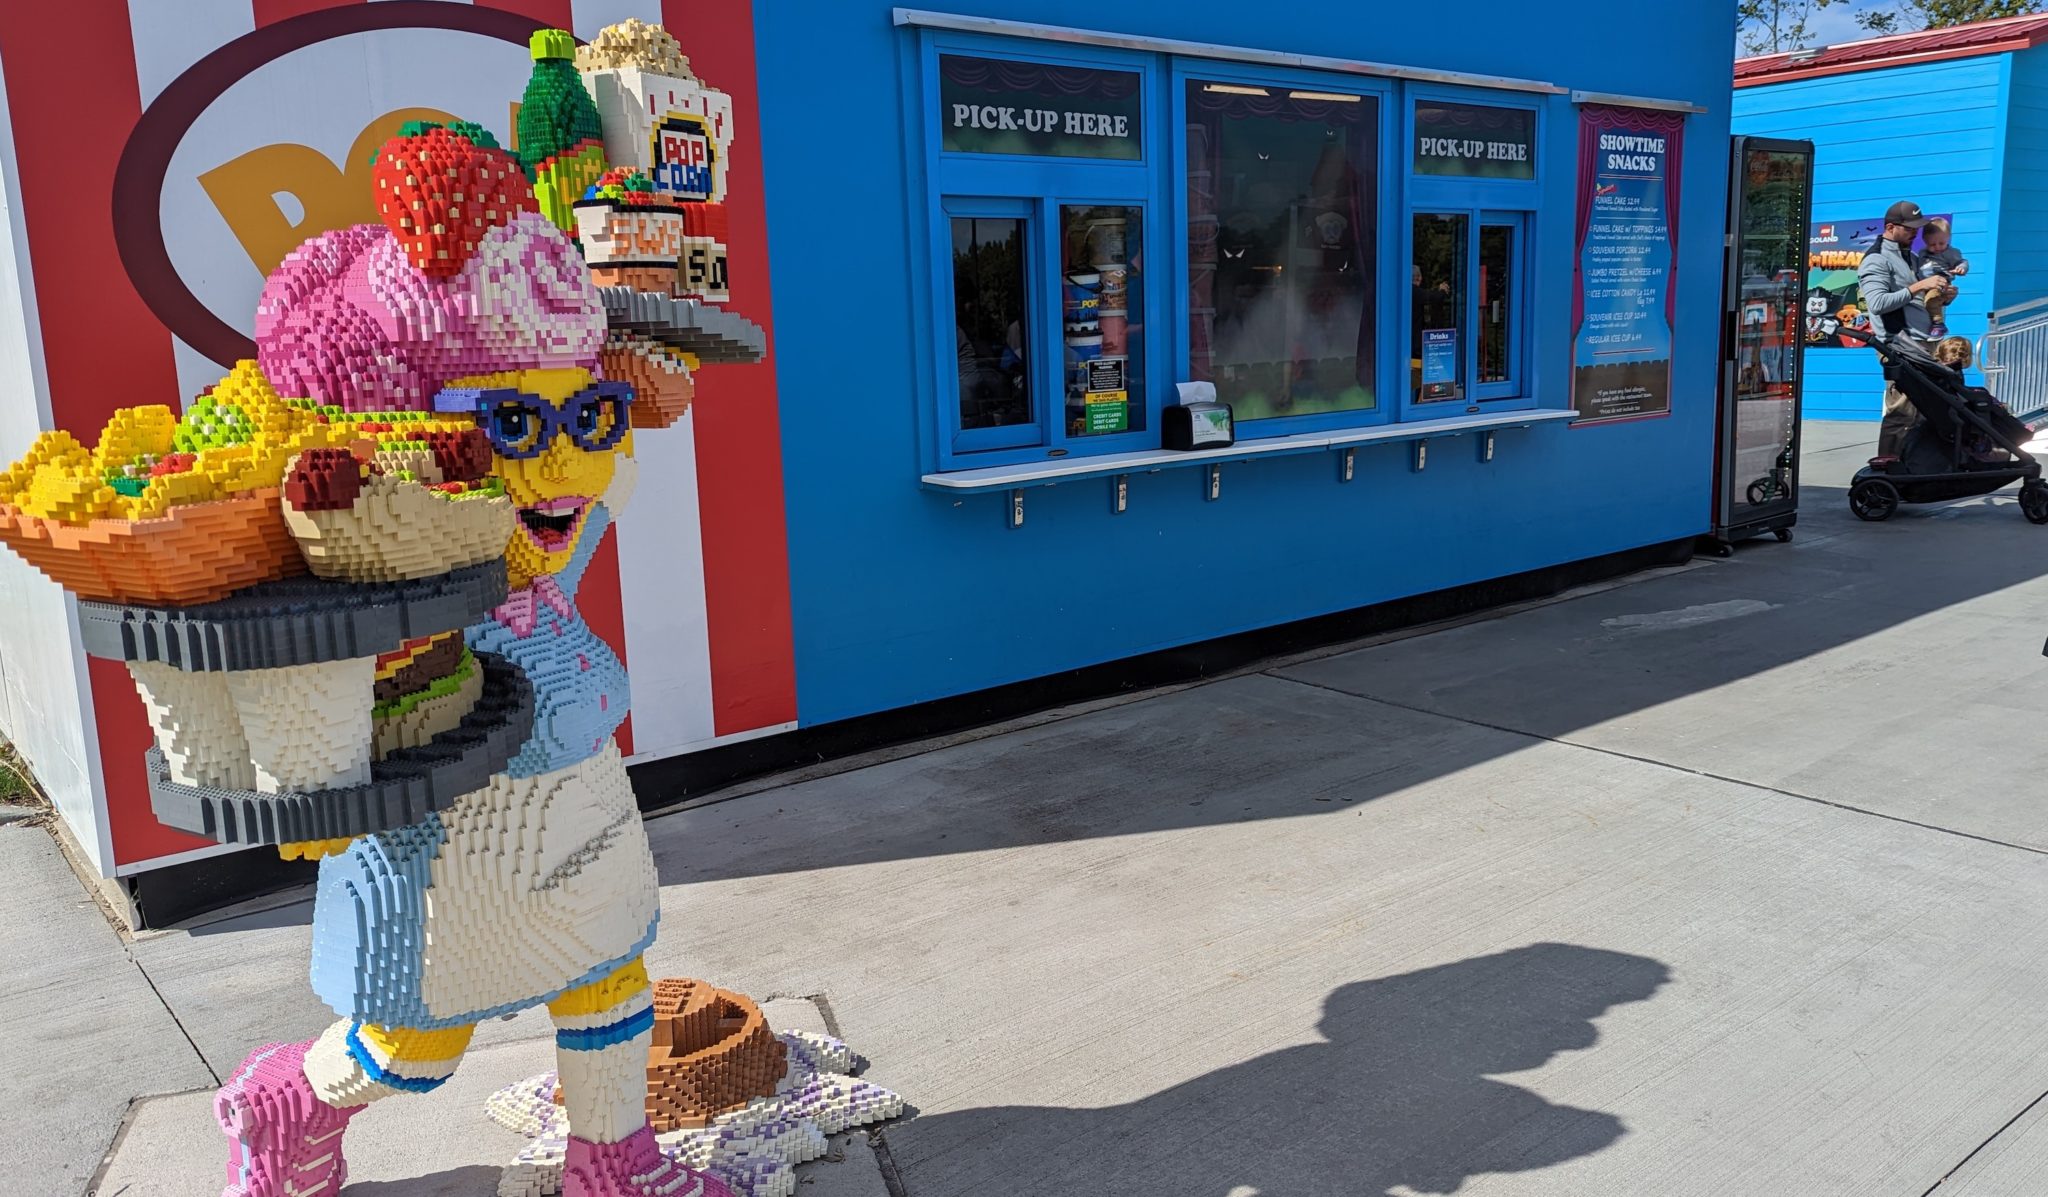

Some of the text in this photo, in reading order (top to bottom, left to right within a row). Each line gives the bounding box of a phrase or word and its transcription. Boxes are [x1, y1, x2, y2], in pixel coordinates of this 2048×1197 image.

[952, 103, 1129, 138] PICK-UP HERE
[664, 136, 704, 166] POP
[1420, 137, 1527, 161] PICK-UP HERE
[1600, 134, 1665, 153] SHOWTIME
[1608, 154, 1656, 171] SNACKS
[655, 164, 713, 192] CORN
[1429, 332, 1449, 341] Drinks
